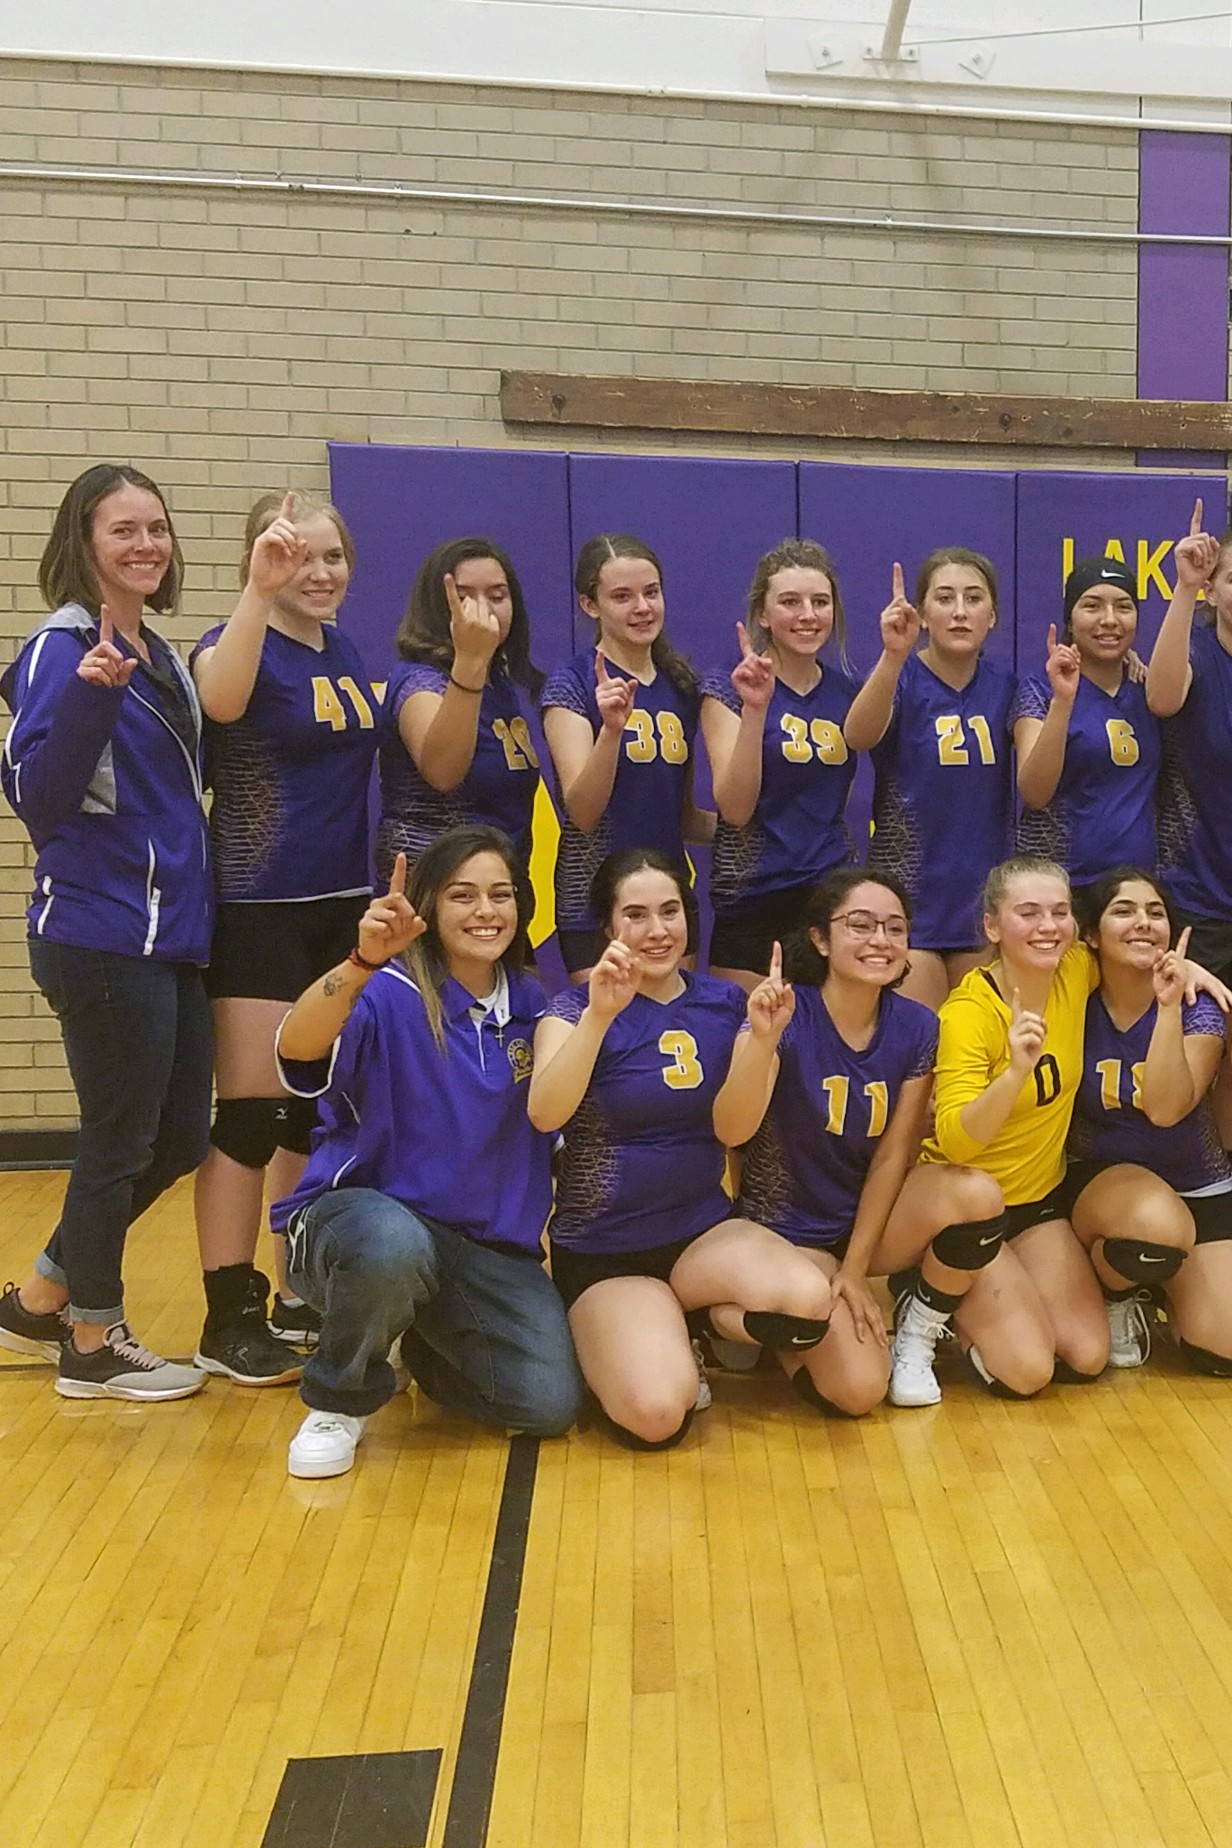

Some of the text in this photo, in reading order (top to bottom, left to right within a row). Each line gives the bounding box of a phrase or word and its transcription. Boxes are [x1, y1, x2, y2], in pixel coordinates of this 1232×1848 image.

[311, 676, 375, 732] 41
[623, 708, 689, 765] 38
[779, 713, 849, 766] 39
[934, 714, 997, 765] 21
[1105, 718, 1140, 767] 6
[658, 1030, 704, 1090] 3
[822, 1075, 889, 1137] 11
